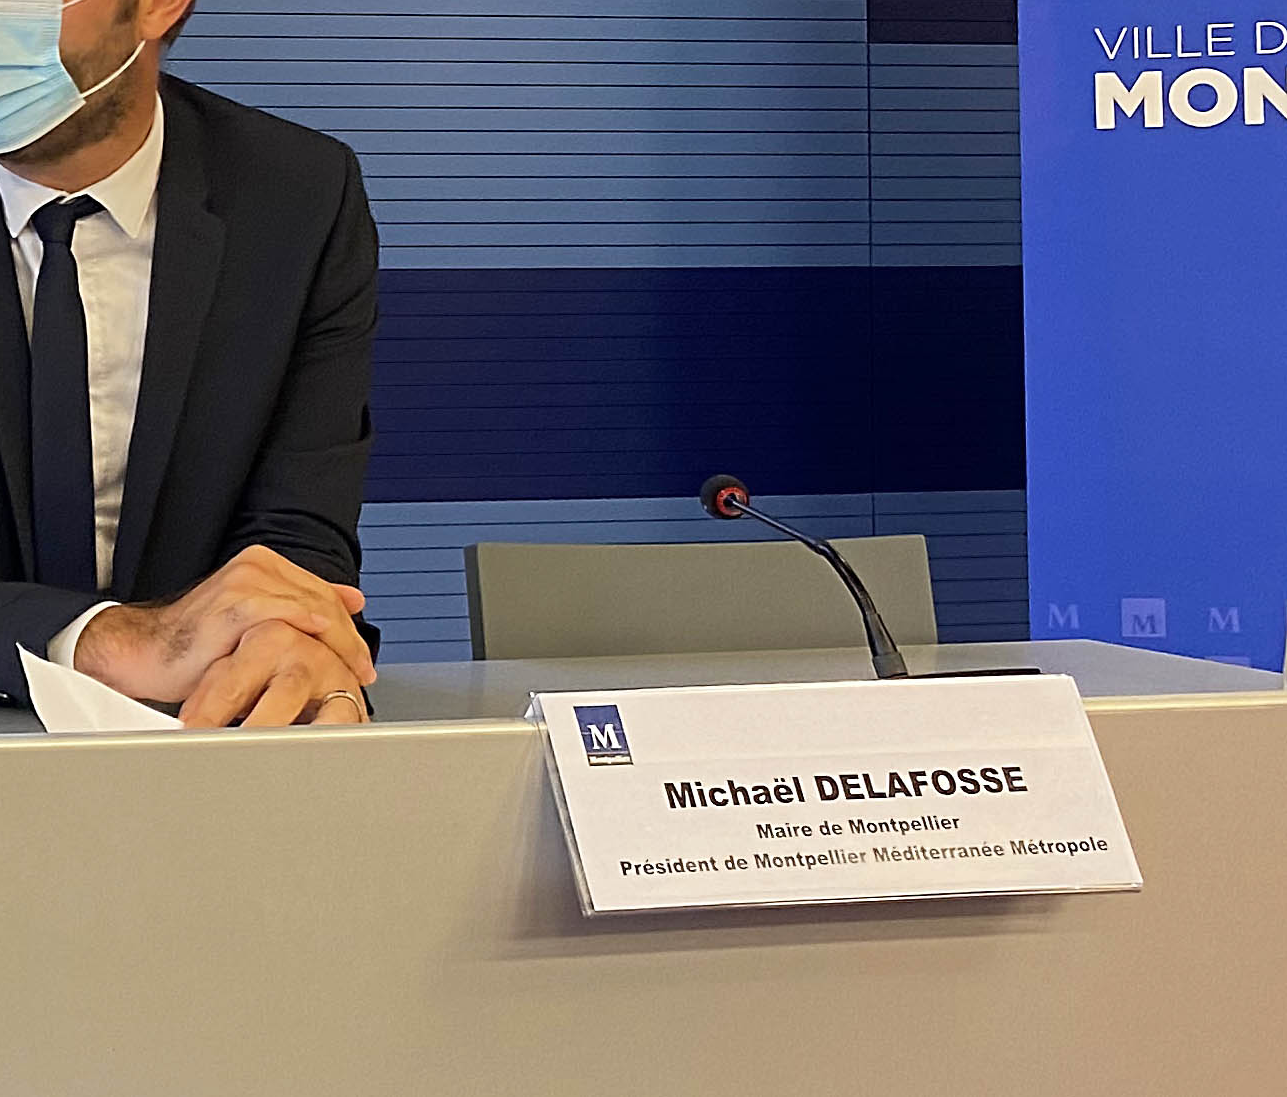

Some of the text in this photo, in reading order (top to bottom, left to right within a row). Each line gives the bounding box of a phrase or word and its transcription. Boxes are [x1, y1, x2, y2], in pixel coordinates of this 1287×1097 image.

[1094, 22, 1236, 60] VILLE
[1095, 66, 1287, 130] MON
[1048, 603, 1080, 630] M
[1208, 606, 1241, 633] M
[587, 723, 622, 750] M
[663, 766, 1028, 809] Michaël DELAFOSSE
[756, 815, 960, 839] Maire de Montpellier
[620, 836, 1108, 876] Président de Montpellier Méditerranée Métropole
